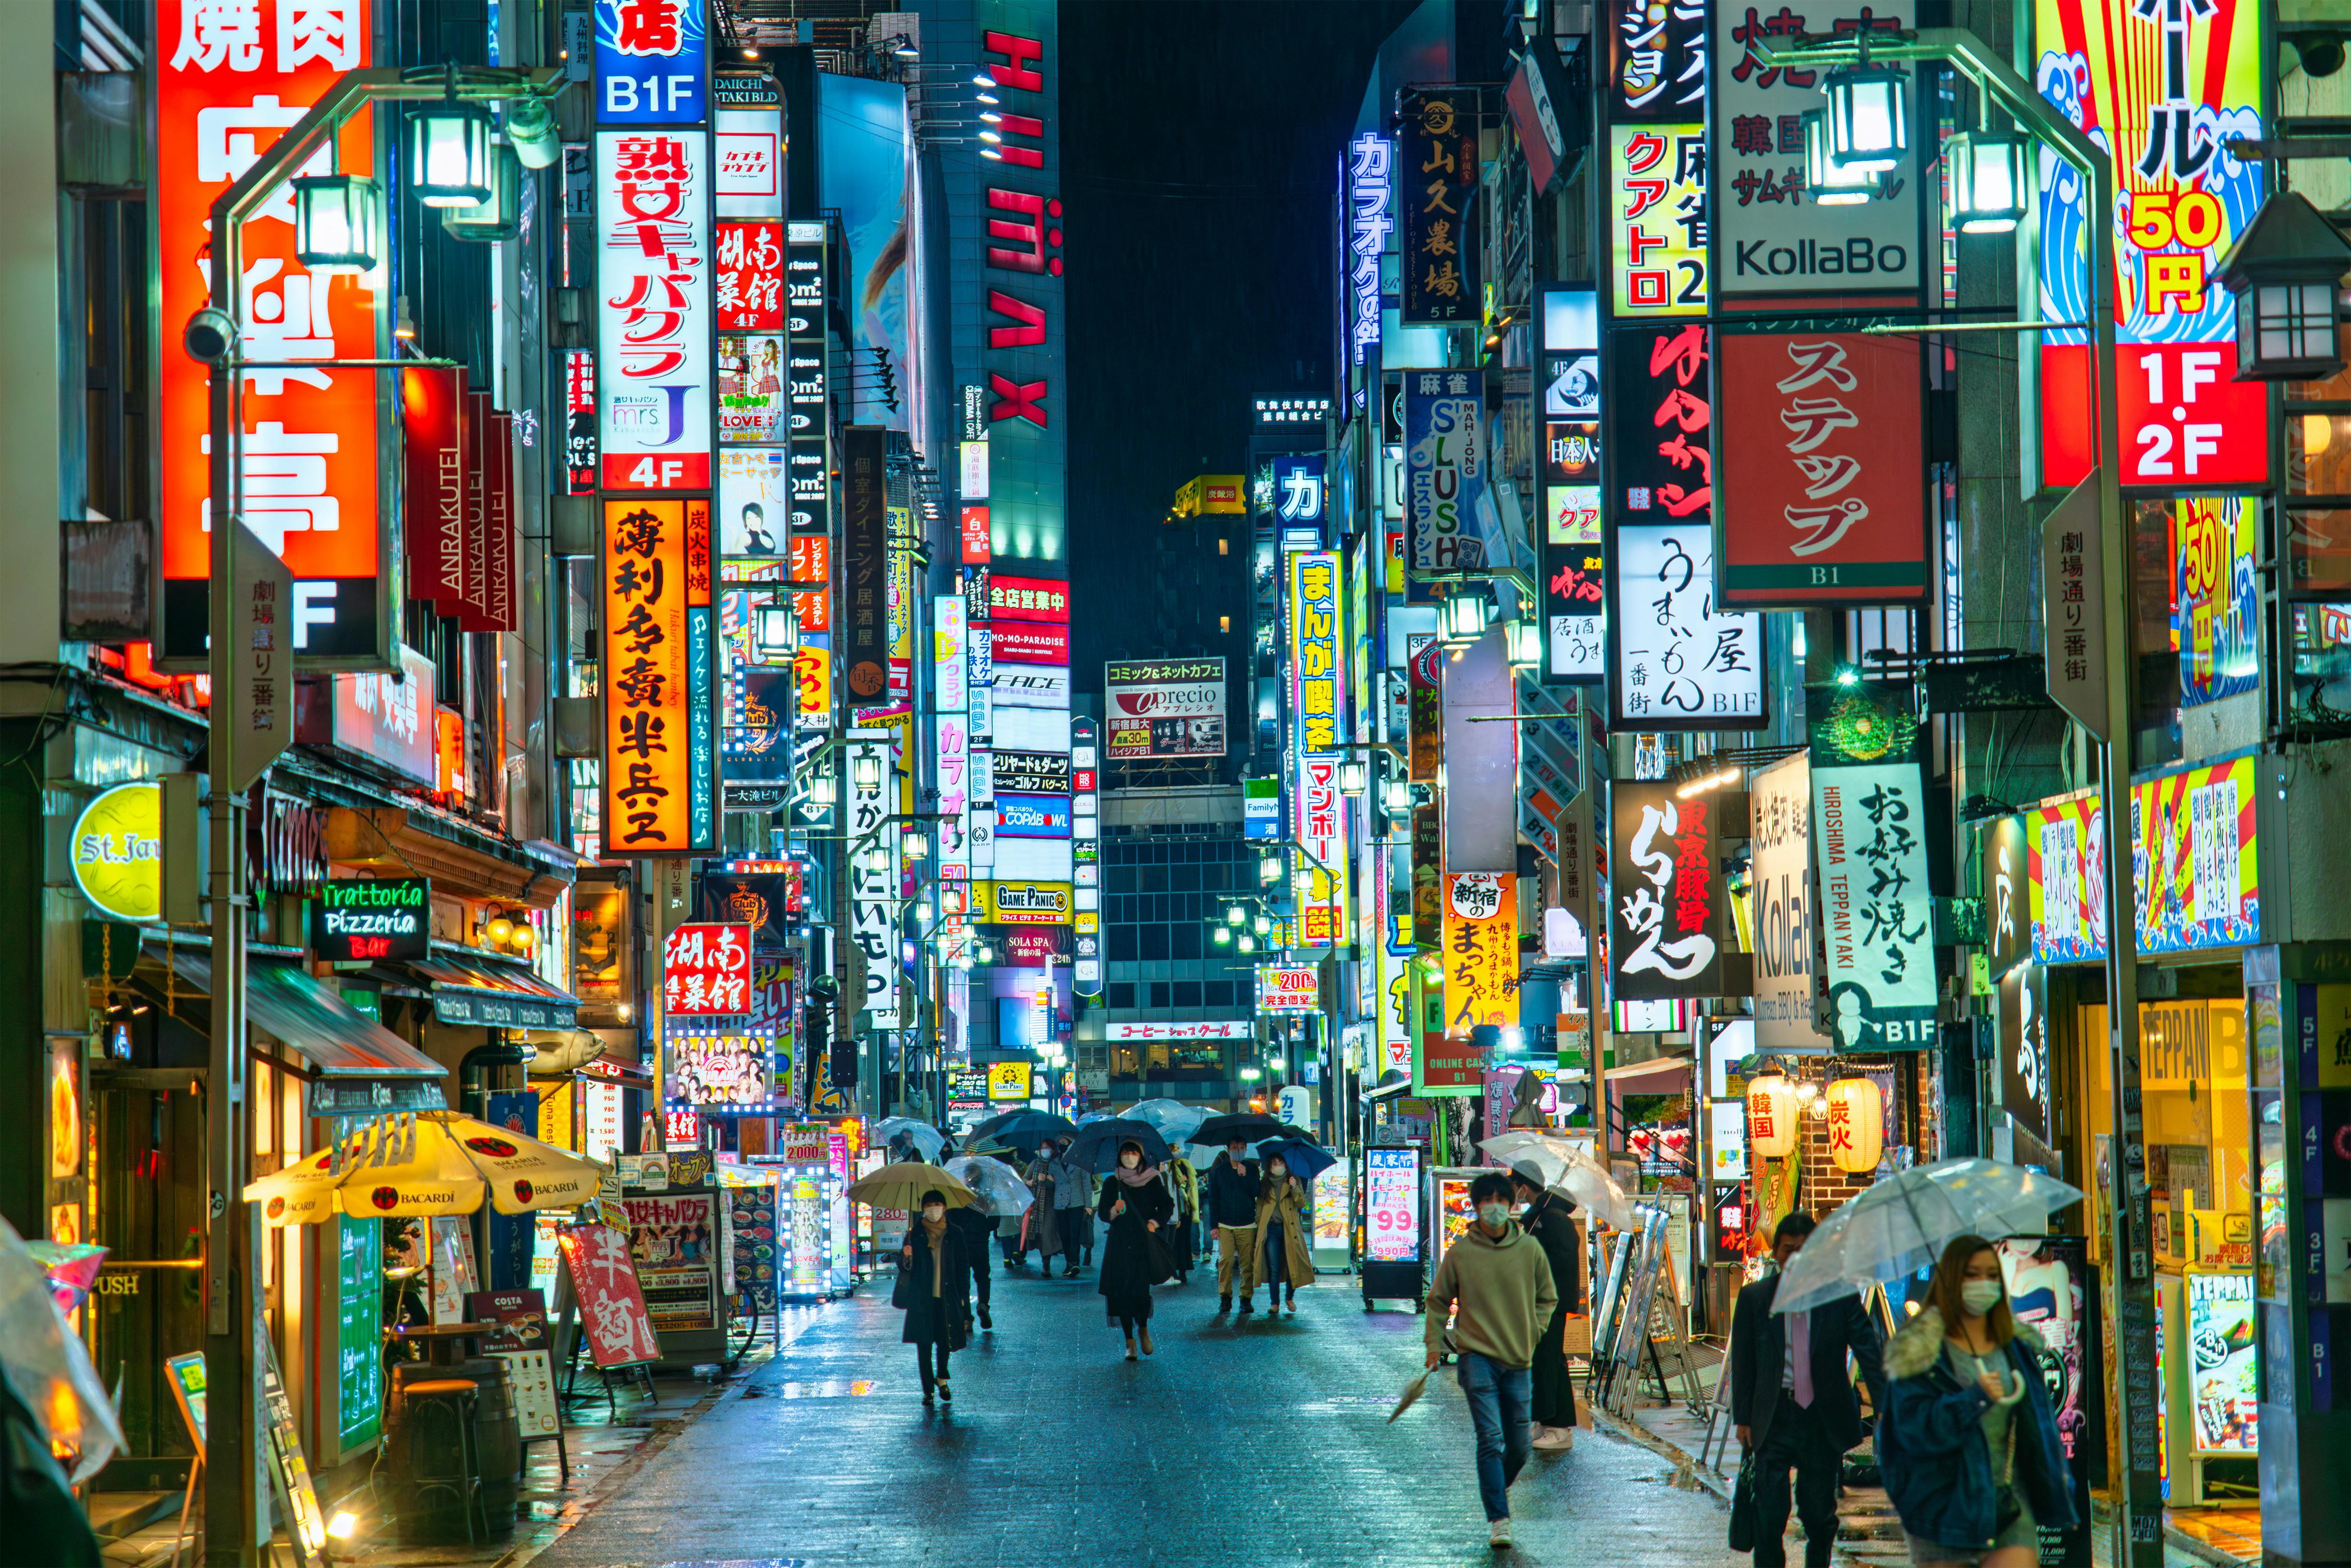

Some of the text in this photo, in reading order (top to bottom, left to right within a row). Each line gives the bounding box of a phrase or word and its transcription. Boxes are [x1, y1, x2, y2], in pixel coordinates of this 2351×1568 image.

[606, 75, 694, 112] B1F
[751, 92, 777, 102] BLD
[720, 162, 769, 172] ラウンジ
[726, 151, 765, 161] カブキ
[1422, 141, 1460, 298] 山久農場
[1624, 132, 1670, 307] クアトロ
[2129, 192, 2222, 251] 50
[607, 136, 702, 380] 熟女キャバクラ
[1736, 237, 1907, 276] KollaBo
[717, 273, 779, 312] 菜館
[2145, 253, 2206, 315] 円
[734, 313, 758, 326] 4F
[1552, 361, 1567, 375] 4F
[2140, 351, 2221, 403] 1F
[1420, 374, 1467, 395] 麻雀
[637, 386, 700, 446] J
[724, 416, 761, 427] LOVE
[1464, 404, 1475, 474] MAH-JONG
[1551, 438, 1596, 464] 日本人
[1776, 341, 1868, 557] ステップ
[2137, 424, 2223, 475] 2F
[630, 457, 683, 487] 4F
[440, 447, 460, 591] ANRAKUTEI
[1417, 475, 1432, 566] エスラッシュ
[970, 518, 988, 552] 白木屋
[688, 510, 709, 591] 炭火串焼
[855, 457, 873, 646] 個室ダイニング居酒屋
[1811, 567, 1838, 583] B1
[813, 595, 822, 624] ホステル
[991, 586, 1065, 612] 全店営業中
[2061, 531, 2087, 681] 劇場通り一番街
[992, 634, 1064, 646] MO-MO-PARADISE
[1412, 638, 1428, 648] 3F
[979, 630, 991, 678] カラオケ
[1299, 560, 1339, 757] まんが喫茶
[992, 675, 1066, 690] FACE
[1111, 665, 1221, 680] コミック&ネットカフェ
[1136, 685, 1216, 713] aprecio
[1527, 692, 1539, 702] 4
[1713, 693, 1756, 712] B1F
[971, 691, 985, 733] SEGA
[1111, 719, 1150, 730] 新宿最大
[1527, 723, 1540, 735] 3
[993, 755, 1067, 774] ビリヤード&ダーツ
[1111, 746, 1151, 756] ハイジアB1
[1526, 755, 1540, 768] 2
[694, 745, 708, 822] 楽しいお店
[972, 756, 986, 798] SEGA
[1015, 776, 1068, 790] ゴルフ バグース
[1540, 765, 1555, 781] TV
[1308, 762, 1336, 862] マンボー
[1265, 824, 1276, 834] 酒
[1526, 818, 1546, 837] B1
[1823, 787, 1846, 866] HIROSHIMA
[2226, 786, 2237, 878] 唐揚げ
[1565, 822, 1579, 898] 劇場通り一番街
[2203, 792, 2214, 913] 鶏つまみ
[2214, 789, 2225, 912] 鉄板焼き
[1675, 801, 1710, 934] 東京豚骨
[2050, 830, 2059, 930] ラーメン
[998, 886, 1054, 907] GAME PANIC
[1454, 883, 1499, 906] 新宿
[1855, 783, 1927, 985] お好み焼き
[325, 908, 416, 934] Pizzeria
[1470, 906, 1484, 917] の
[349, 936, 392, 958] Bar
[1009, 938, 1049, 946] SOLA SPA
[1500, 922, 1512, 967] 博多もつ鍋
[1454, 922, 1486, 1026] まっちゃん
[1487, 924, 1499, 1000] 九州のうまかもん
[682, 974, 743, 1012] 菜館
[1265, 994, 1310, 1007] 完全個室
[1057, 1022, 1071, 1032] 受付
[1121, 1024, 1231, 1037] コーヒー ショップ クール
[1886, 1020, 1934, 1041] B1F
[2304, 1017, 2314, 1053] 5F
[2142, 1008, 2207, 1080] TEPPAN
[1430, 1058, 1462, 1068] ONLINE
[1455, 1072, 1465, 1081] B1
[1010, 1082, 1024, 1091] PANIC
[545, 1095, 556, 1122] Tuna
[1752, 1093, 1774, 1138] 韓国
[668, 1112, 695, 1138] 菜館
[1829, 1100, 1853, 1150] 炭火
[788, 1146, 827, 1160] 2,000円
[2306, 1126, 2317, 1160] 4F
[670, 1152, 710, 1182] オープン
[1372, 1153, 1399, 1167] 炭家
[402, 1191, 454, 1203] BACARDÍ
[535, 1180, 578, 1194] BACARDÍ
[285, 1199, 316, 1213] BACARDÍ
[875, 1209, 908, 1220] 280円
[1377, 1210, 1411, 1231] 99
[1376, 1246, 1410, 1257] 990円
[2313, 1343, 2324, 1377] B1
